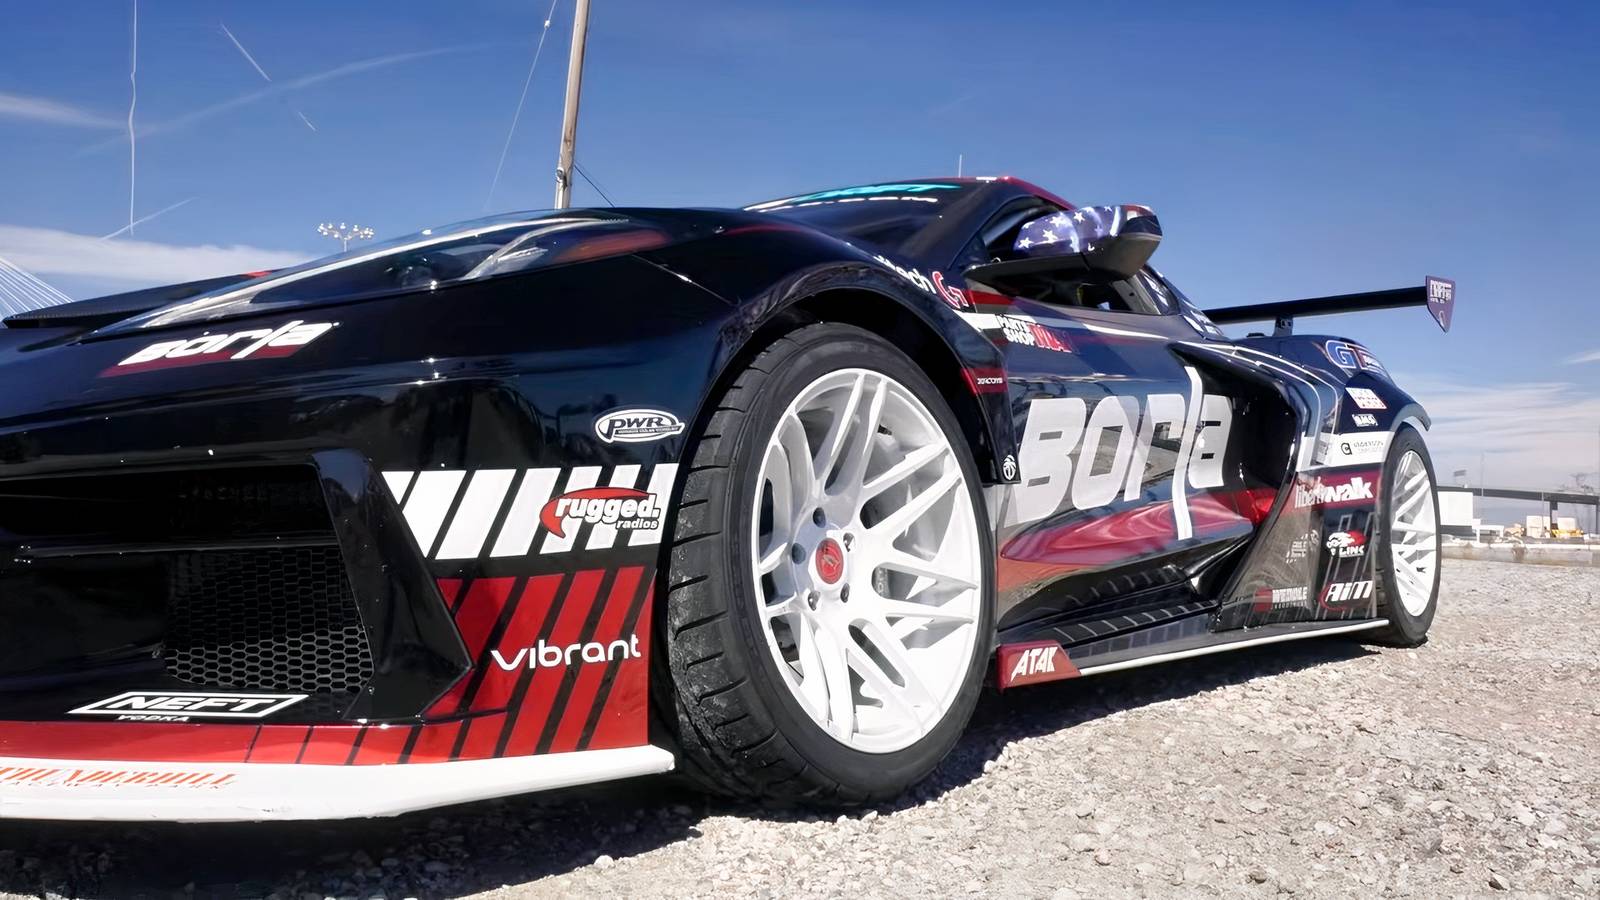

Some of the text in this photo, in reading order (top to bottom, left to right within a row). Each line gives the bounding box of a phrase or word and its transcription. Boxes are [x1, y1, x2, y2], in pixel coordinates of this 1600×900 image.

[605, 416, 664, 440] PWR
[616, 518, 659, 529] radios
[105, 696, 277, 713] NEFT
